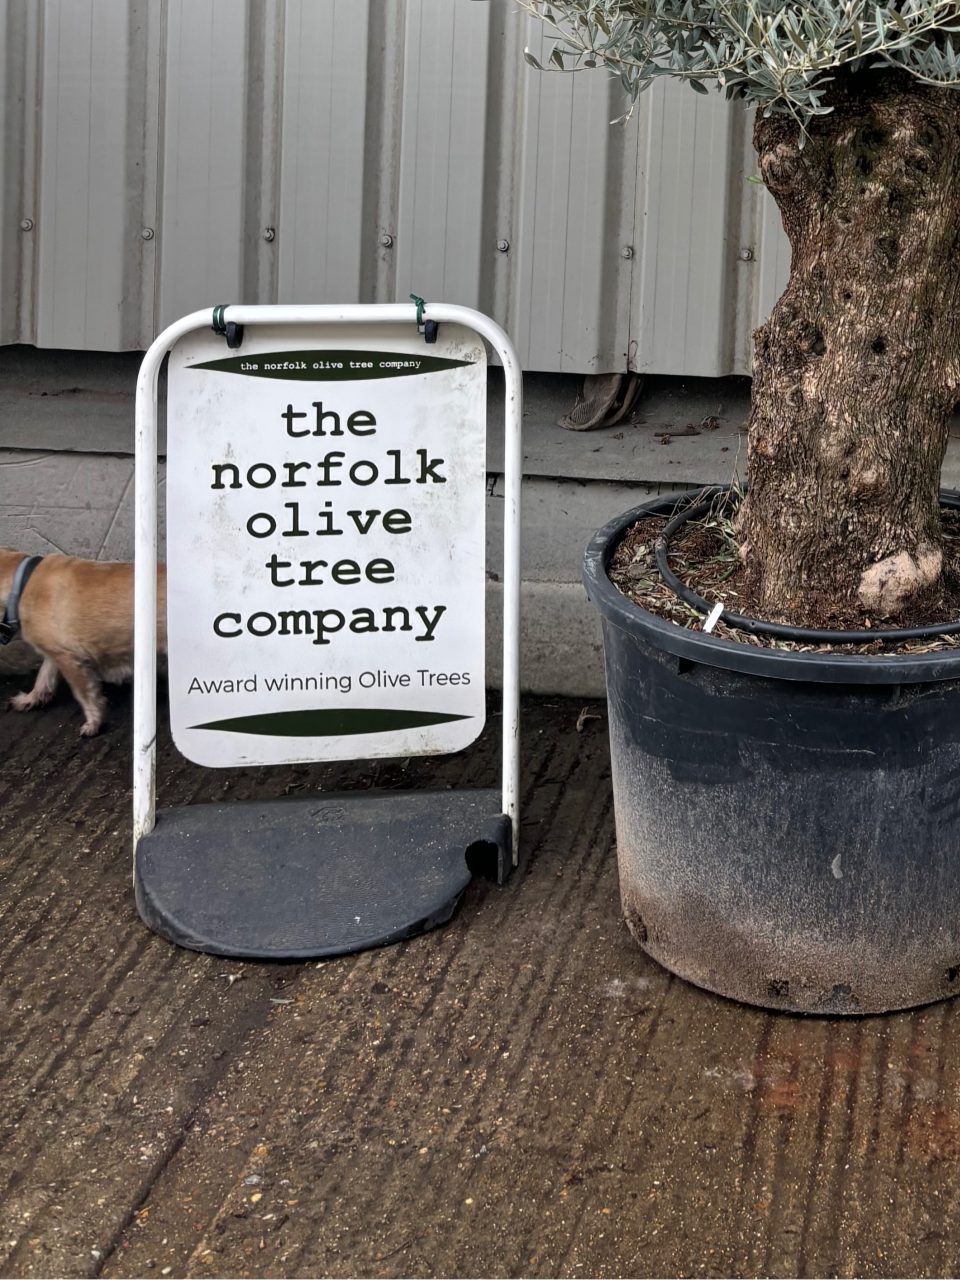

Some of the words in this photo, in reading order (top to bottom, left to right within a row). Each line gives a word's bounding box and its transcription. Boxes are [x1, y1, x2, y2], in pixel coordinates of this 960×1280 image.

[240, 362, 259, 371] the
[263, 361, 308, 370] norfolk
[312, 360, 344, 369] olive
[349, 361, 374, 369] tree
[379, 360, 422, 370] company
[281, 402, 377, 438] the
[210, 449, 447, 490] norfolk
[246, 501, 412, 539] olive
[265, 553, 395, 587] tree
[213, 604, 447, 645] company
[187, 674, 258, 695] Award
[264, 670, 352, 694] winning
[358, 669, 411, 689] Olive
[416, 668, 471, 687] Trees
